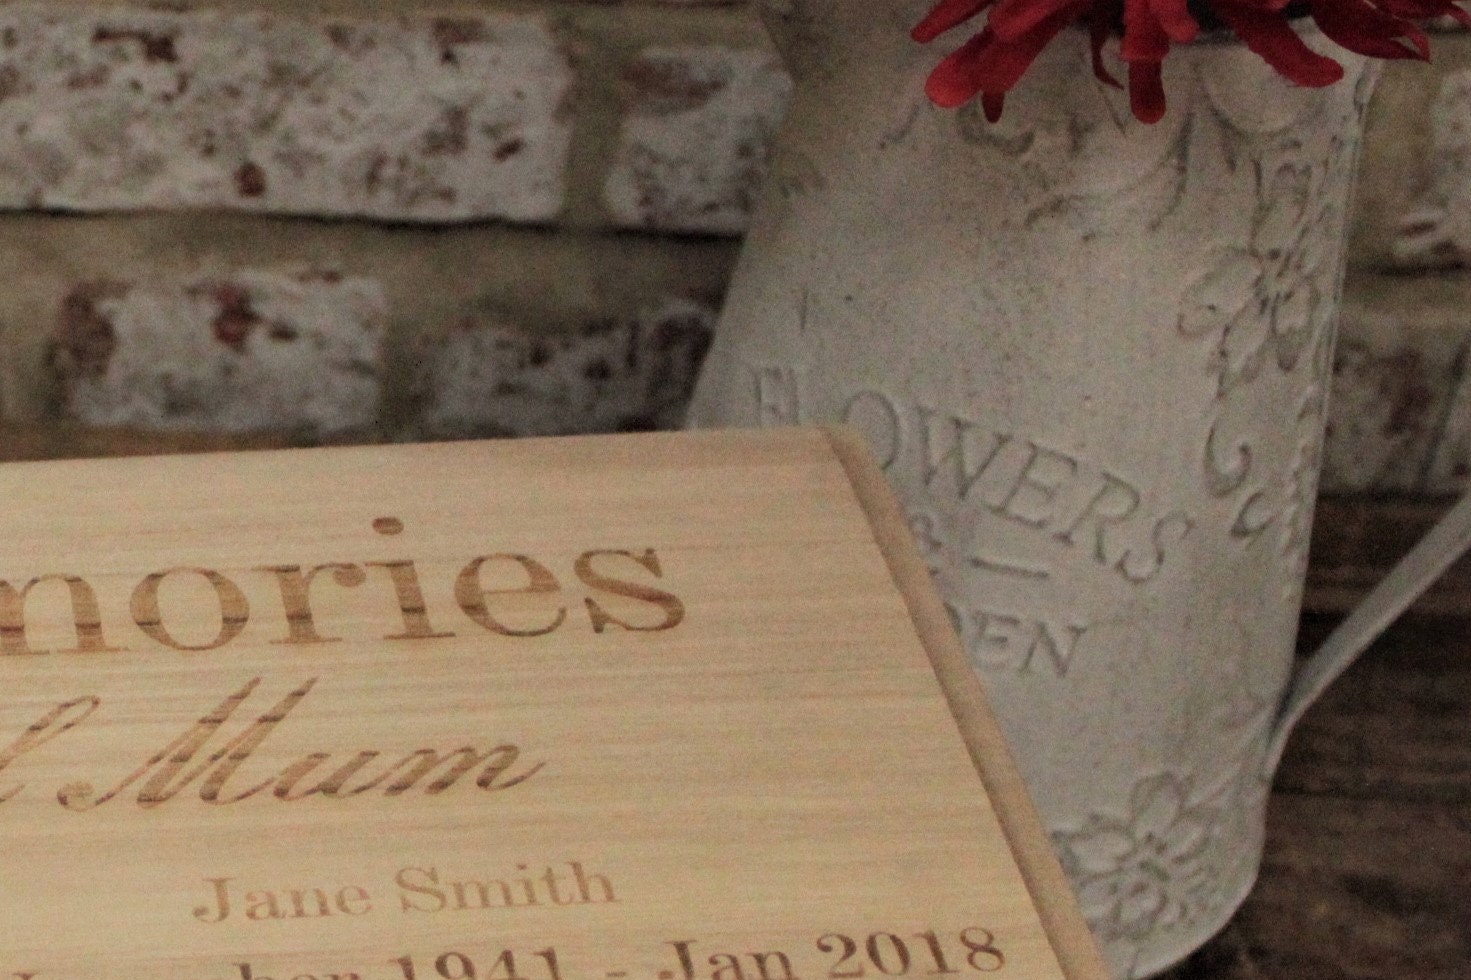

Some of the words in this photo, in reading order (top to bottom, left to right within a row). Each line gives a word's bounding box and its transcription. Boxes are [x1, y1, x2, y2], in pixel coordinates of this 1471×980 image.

[56, 676, 546, 812] Mum
[191, 876, 373, 924] Jane
[394, 861, 620, 915] Smith
[816, 926, 1007, 979] 2018
